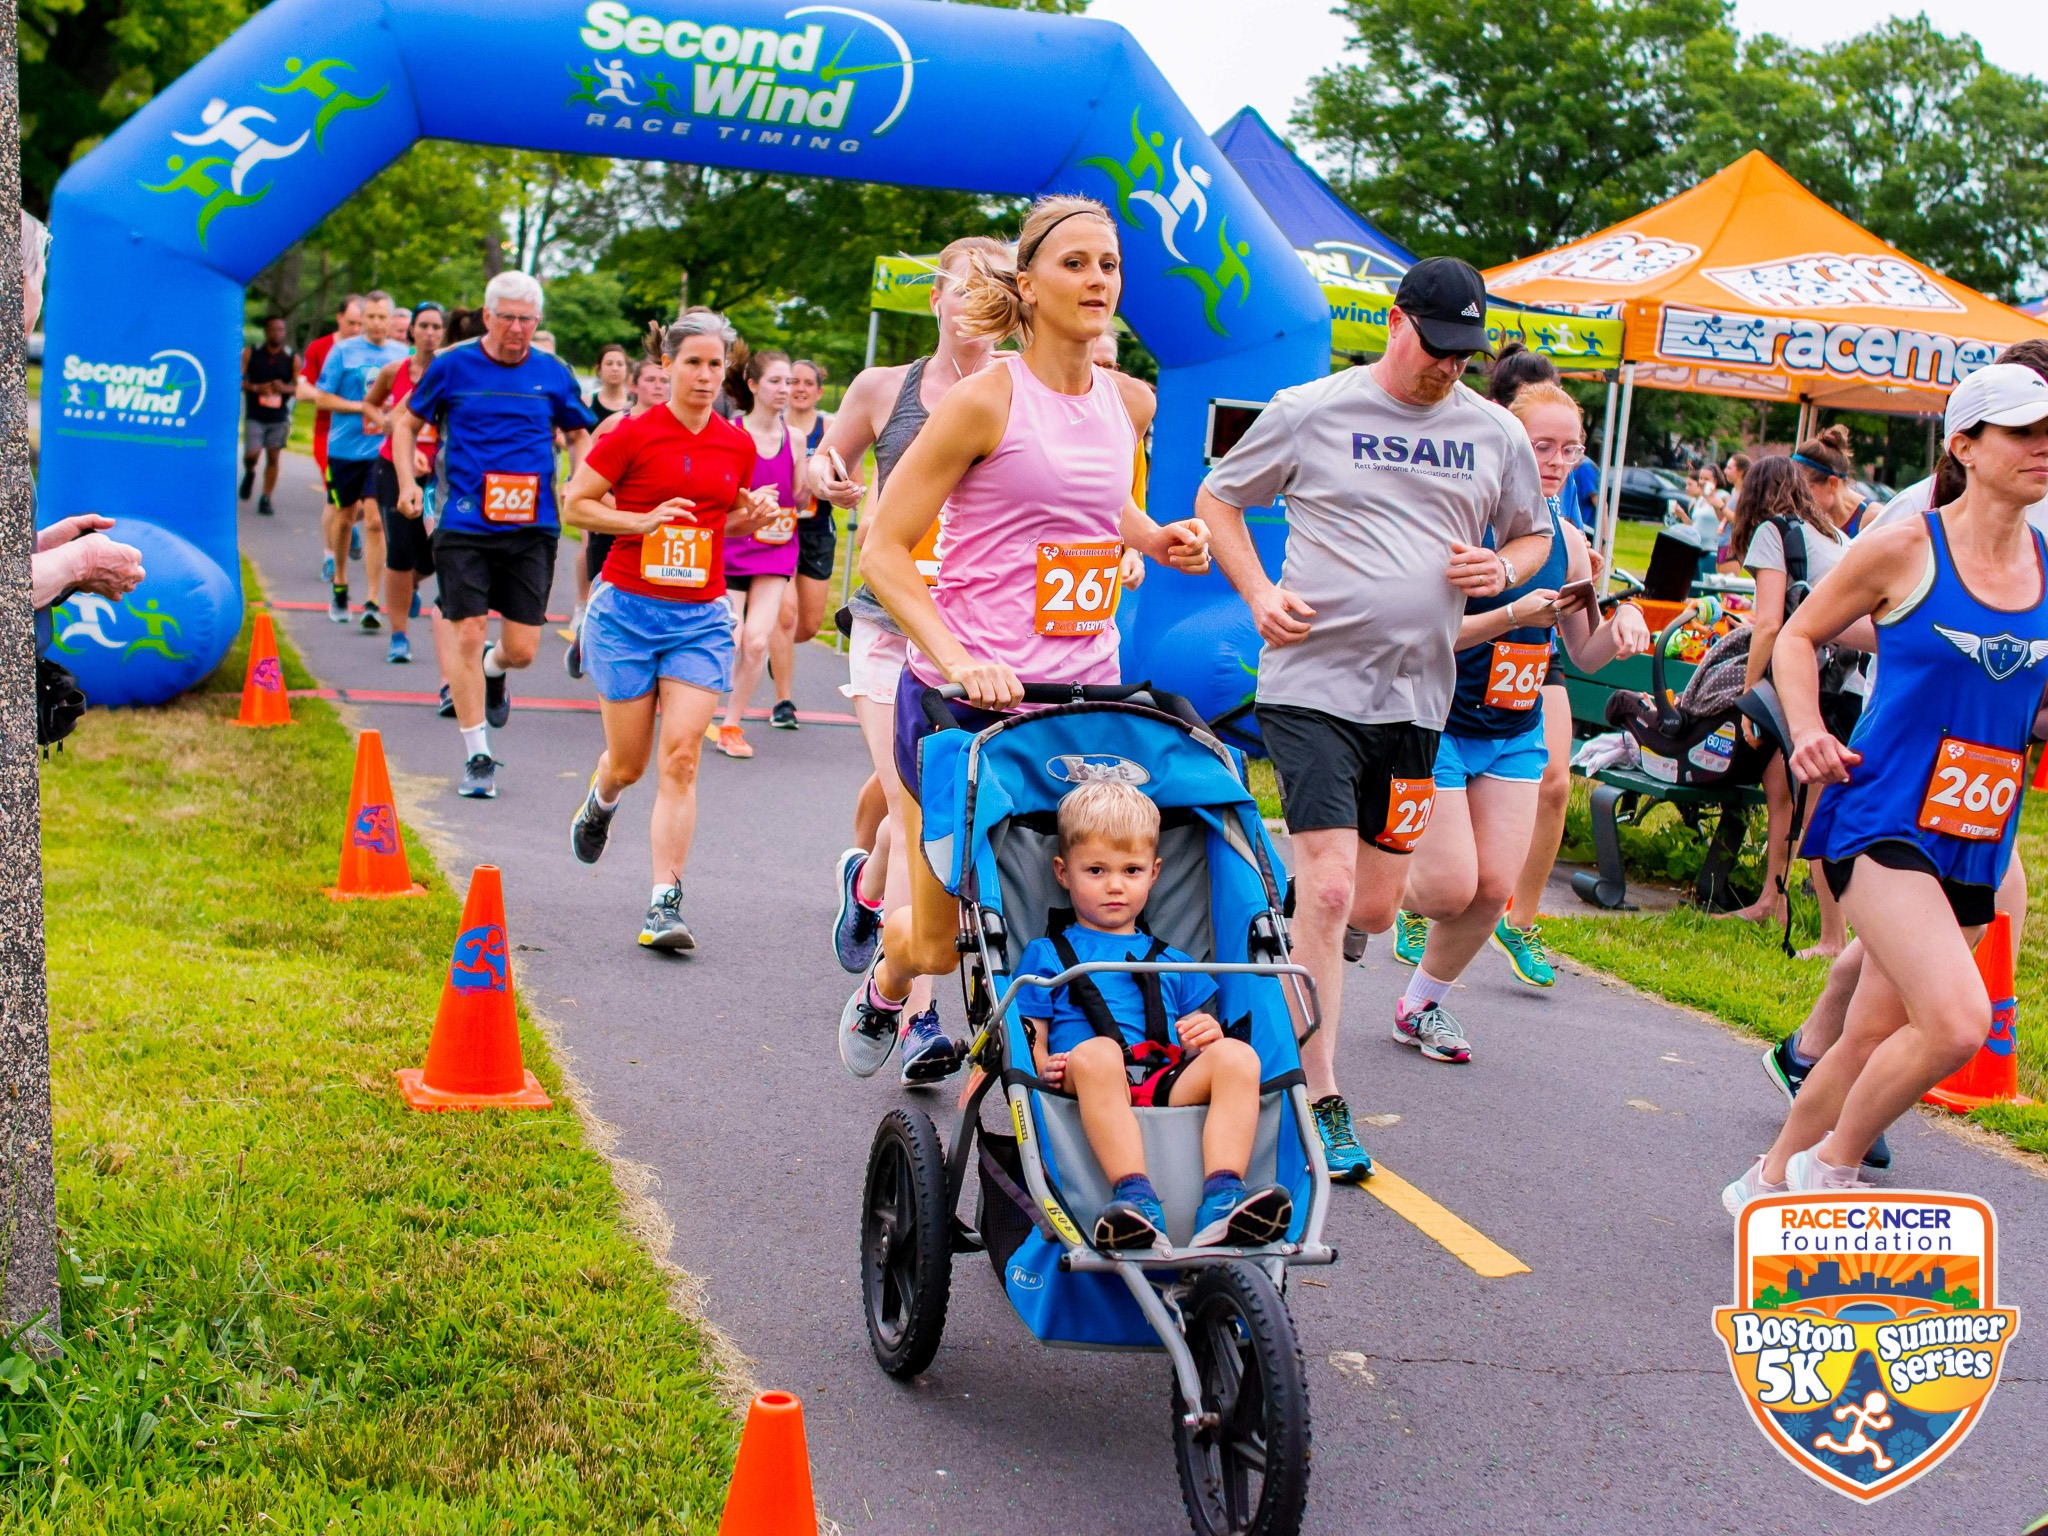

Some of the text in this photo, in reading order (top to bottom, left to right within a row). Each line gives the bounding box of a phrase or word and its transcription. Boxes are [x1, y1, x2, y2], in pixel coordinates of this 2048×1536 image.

[580, 0, 824, 73] Second
[692, 64, 859, 130] Wind
[586, 112, 861, 153] RACE TIMING
[1763, 318, 2003, 385] raceme
[63, 354, 168, 388] Second
[105, 383, 182, 415] Wind
[118, 411, 186, 428] TIMING
[1351, 432, 1475, 472] RSAM
[1373, 463, 1409, 473] Syndrome
[1410, 466, 1451, 478] Association
[1451, 471, 1460, 479] of
[1461, 472, 1473, 481] MA
[489, 486, 533, 510] 262
[662, 539, 697, 567] 151
[661, 567, 692, 578] LUCINDA
[1041, 566, 1119, 611] 267
[1491, 661, 1547, 693] 265
[1929, 766, 2017, 816] 260
